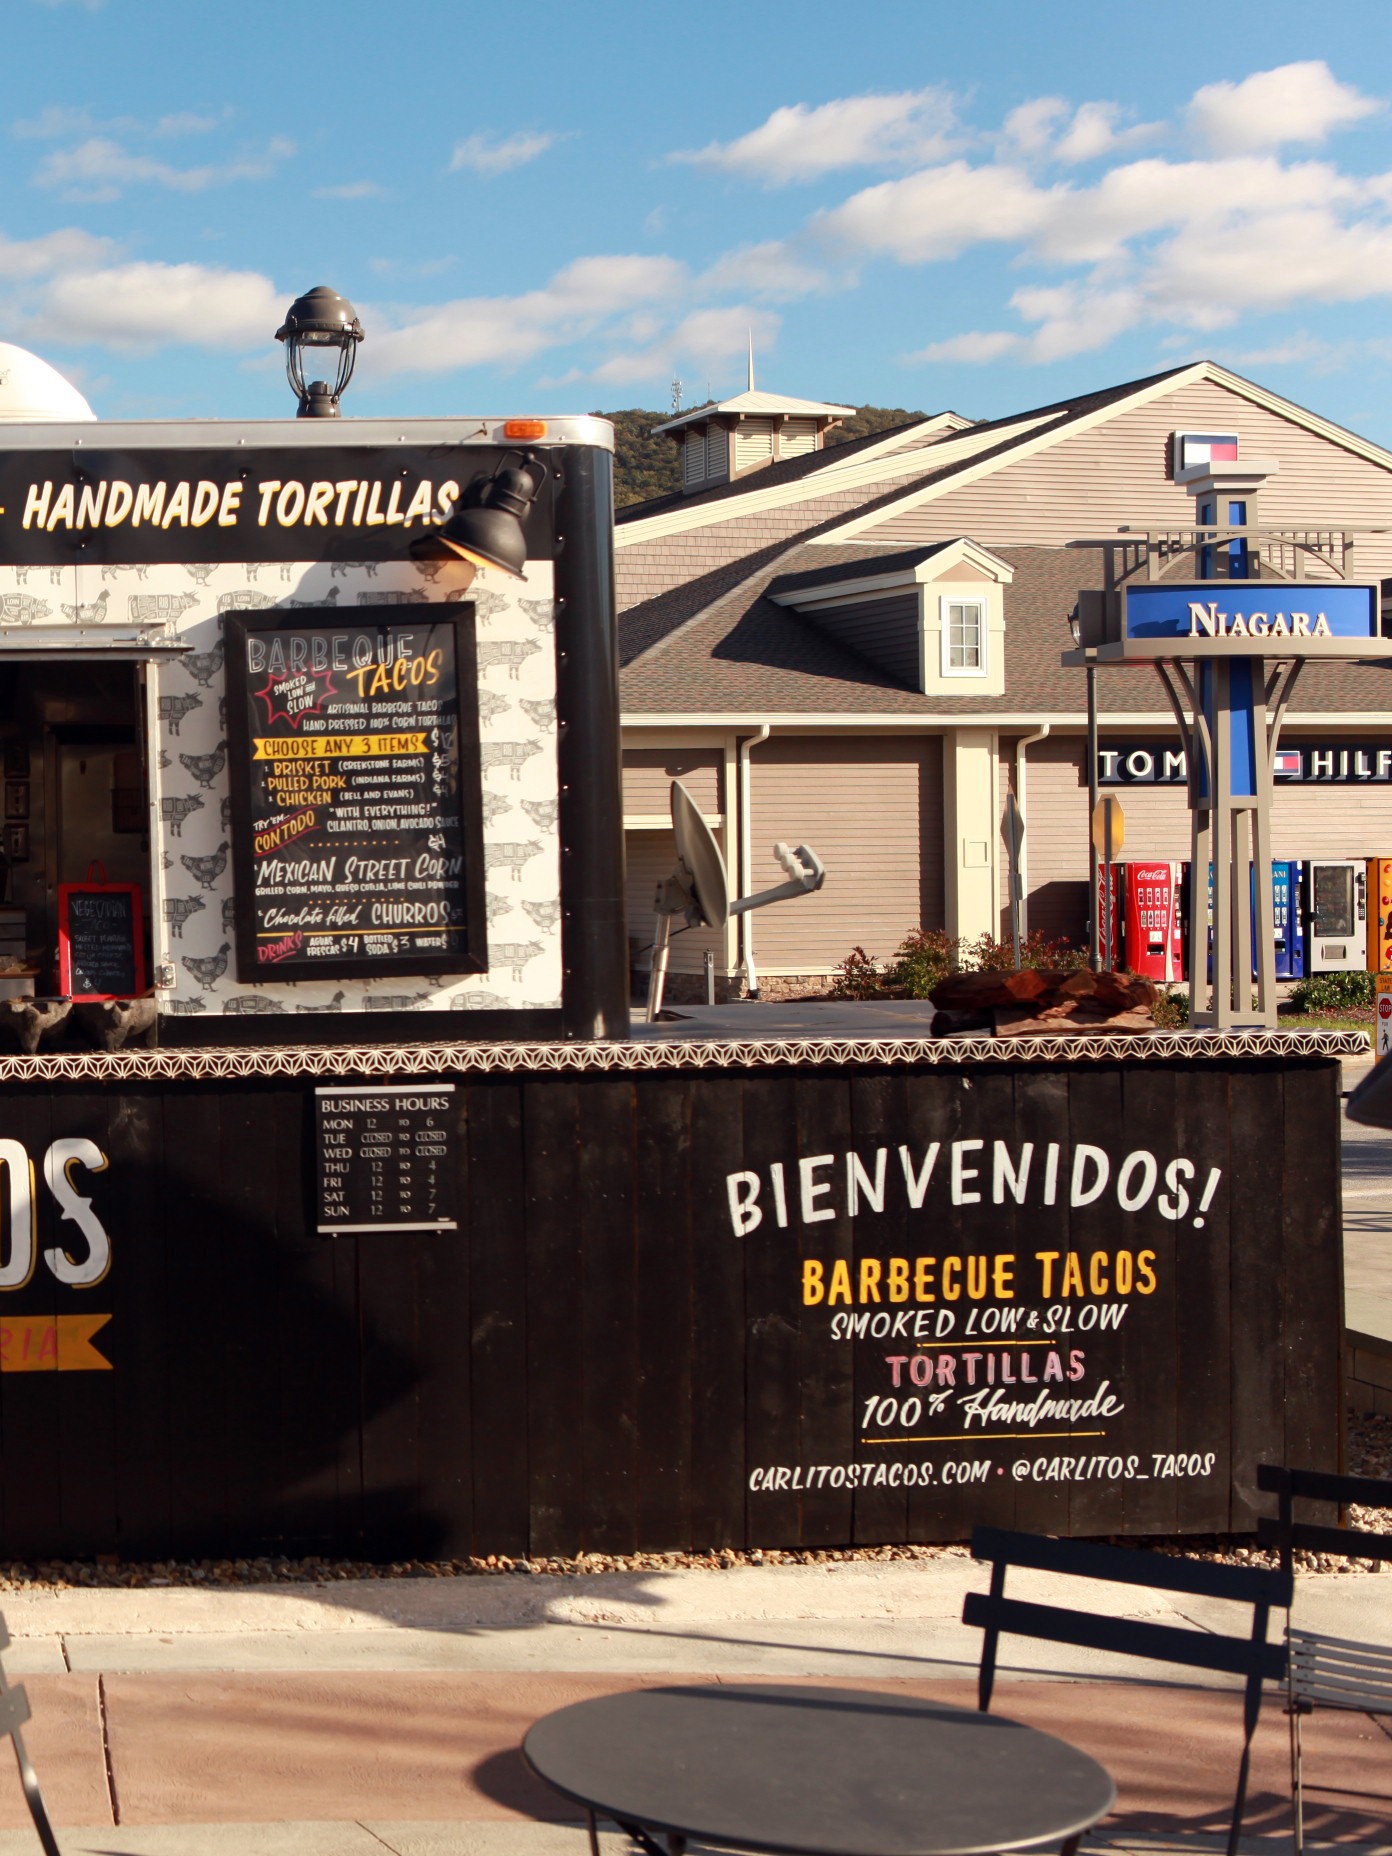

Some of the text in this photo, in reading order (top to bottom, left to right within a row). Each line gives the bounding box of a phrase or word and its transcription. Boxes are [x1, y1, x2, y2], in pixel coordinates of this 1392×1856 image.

[21, 479, 243, 531] HANDMADE
[257, 478, 459, 527] TORTILLAS
[1187, 602, 1332, 637] NIAGARA
[248, 634, 414, 673] BARBEQUE
[346, 648, 443, 698] TACOS
[274, 676, 307, 696] SMOKED
[288, 686, 304, 700] LOW
[287, 694, 314, 716] SLOW
[327, 700, 444, 714] ARTISANAL BARBEQUE TACOS
[303, 720, 326, 731] HAND
[328, 718, 366, 730] PRESSED
[370, 718, 390, 728] 100%
[392, 716, 416, 729] CORN
[264, 739, 318, 756] CHOOSE
[324, 738, 354, 754] ANY
[362, 738, 370, 754] 3
[378, 734, 419, 753] ITEMS
[274, 760, 332, 776] BRISKET
[392, 756, 424, 769] FARMS)
[268, 777, 309, 791] PULLED
[312, 776, 348, 790] PORK
[352, 774, 390, 786] (INDIANA
[392, 772, 426, 784] FARMS)
[276, 790, 332, 806] CHICKEN
[340, 791, 362, 801] (BELL
[363, 790, 381, 800] AND
[383, 789, 414, 800] EVANS)
[253, 819, 269, 832] TRY
[255, 810, 315, 853] CON TODO
[327, 820, 370, 832] CILANTRO,
[398, 816, 434, 830] AVOCADO
[257, 853, 463, 886] MEXICAN STREET CORN
[1138, 870, 1167, 880] Coca-Cola
[255, 885, 284, 896] GRILLED
[388, 882, 406, 890] LIME
[407, 880, 426, 890] CHILI
[264, 905, 324, 928] Chocolate
[326, 905, 363, 927] filled
[372, 900, 450, 925] CHURROS
[257, 930, 302, 962] DRINKS
[309, 936, 334, 946] AGUAS
[363, 934, 394, 944] BOTTLED
[307, 943, 390, 958] FRESCAS SODA
[1380, 1004, 1392, 1012] STOP
[322, 1097, 450, 1112] BUSINESS HOURS
[322, 1119, 353, 1130] MON
[366, 1118, 376, 1128] 12
[426, 1116, 434, 1127] 6
[323, 1134, 346, 1144] TUE
[361, 1132, 392, 1143] CLOSED
[415, 1131, 446, 1142] CLOSED
[324, 1148, 352, 1158] WED
[360, 1147, 392, 1158] CLOSED
[415, 1146, 447, 1156] CLOSED
[324, 1162, 349, 1173] THU
[372, 1162, 383, 1172] 12
[428, 1160, 436, 1170] 4
[324, 1178, 342, 1188] FRI
[372, 1176, 383, 1186] 12
[428, 1174, 435, 1184] 4
[726, 1139, 1222, 1238] BIENVENIDOS!
[324, 1192, 345, 1202] SAT
[371, 1190, 383, 1201] 12
[428, 1188, 436, 1200] 7
[324, 1206, 350, 1216] SUN
[371, 1205, 383, 1216] 12
[428, 1203, 436, 1214] 7
[802, 1249, 1157, 1306] BARBECUE TACOS
[830, 1303, 1129, 1341] SMOKED LOW & SLOW
[885, 1350, 1086, 1388] TORTILLAS
[862, 1381, 1125, 1429] 100% Handmade
[748, 1452, 1216, 1491] CARLITOSTACOS.COM @CARLITOS_TACOS
